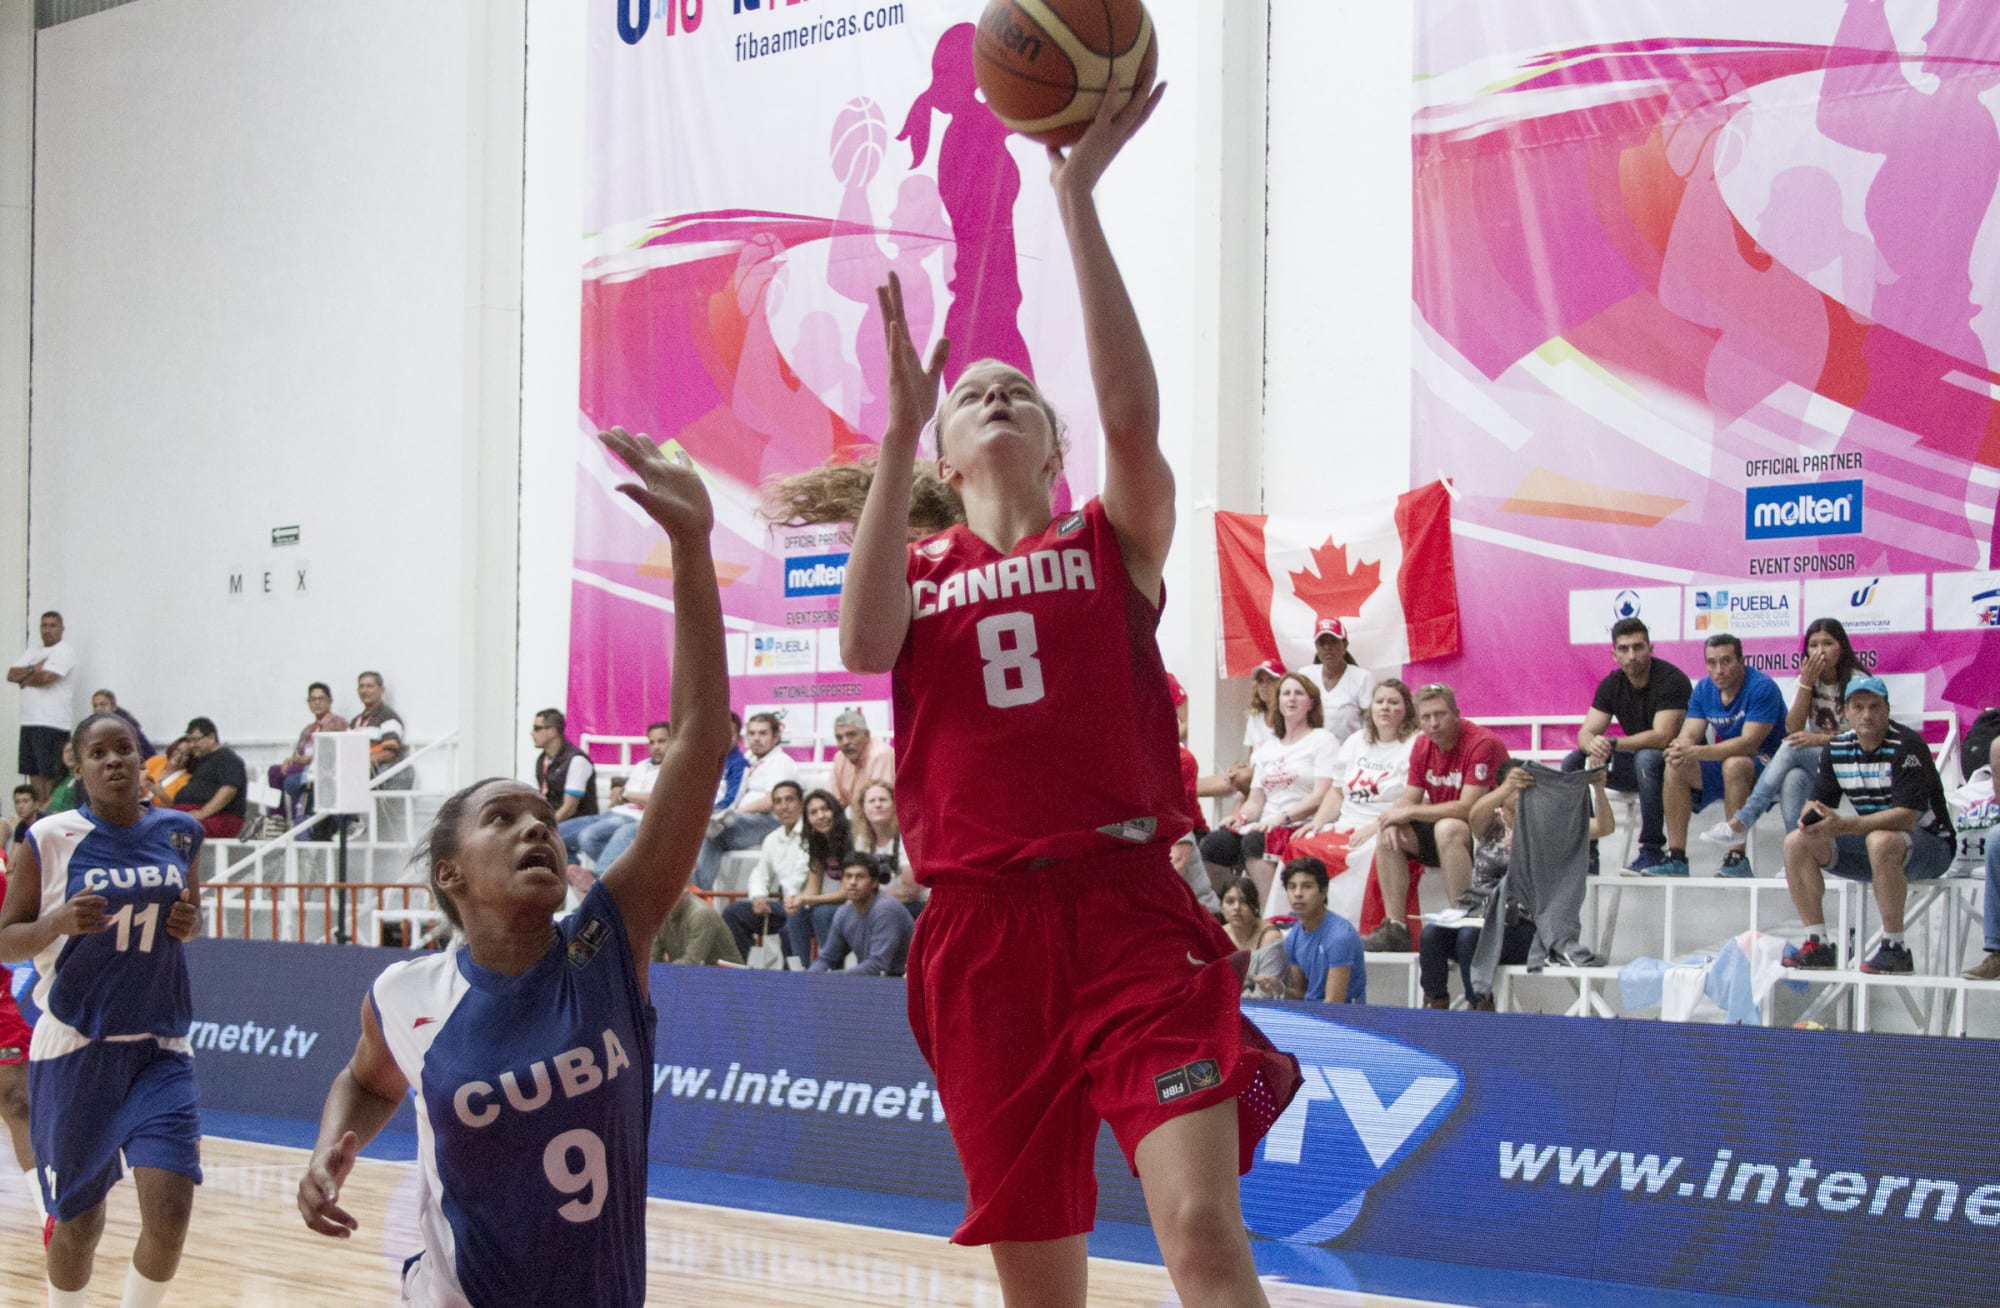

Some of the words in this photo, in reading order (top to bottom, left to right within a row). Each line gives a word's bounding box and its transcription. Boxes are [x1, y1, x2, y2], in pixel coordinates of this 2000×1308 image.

[735, 3, 905, 62] fibaamericas.com
[1746, 457, 1800, 477] OFFICIAL
[1803, 452, 1863, 472] PARTNER
[1754, 494, 1852, 528] molten
[784, 534, 817, 549] OFFICIAL
[1750, 557, 1791, 575] EVENT
[1793, 553, 1855, 574] SPONSOR
[912, 549, 1096, 620] CANADA
[1730, 594, 1789, 612] PUEBLA
[786, 611, 810, 625] EVENT
[813, 609, 840, 623] SPONS
[775, 639, 810, 653] PUEBLA
[976, 610, 1045, 709] 8
[1744, 653, 1790, 671] TIONAL
[774, 684, 810, 698] NATIONAL
[811, 683, 862, 698] SUPPORTERS
[84, 864, 184, 891] CUBA
[107, 902, 160, 953] 11
[188, 1020, 319, 1059] rnetv.tv
[453, 1028, 631, 1128] CUBA
[542, 1128, 609, 1224] 9
